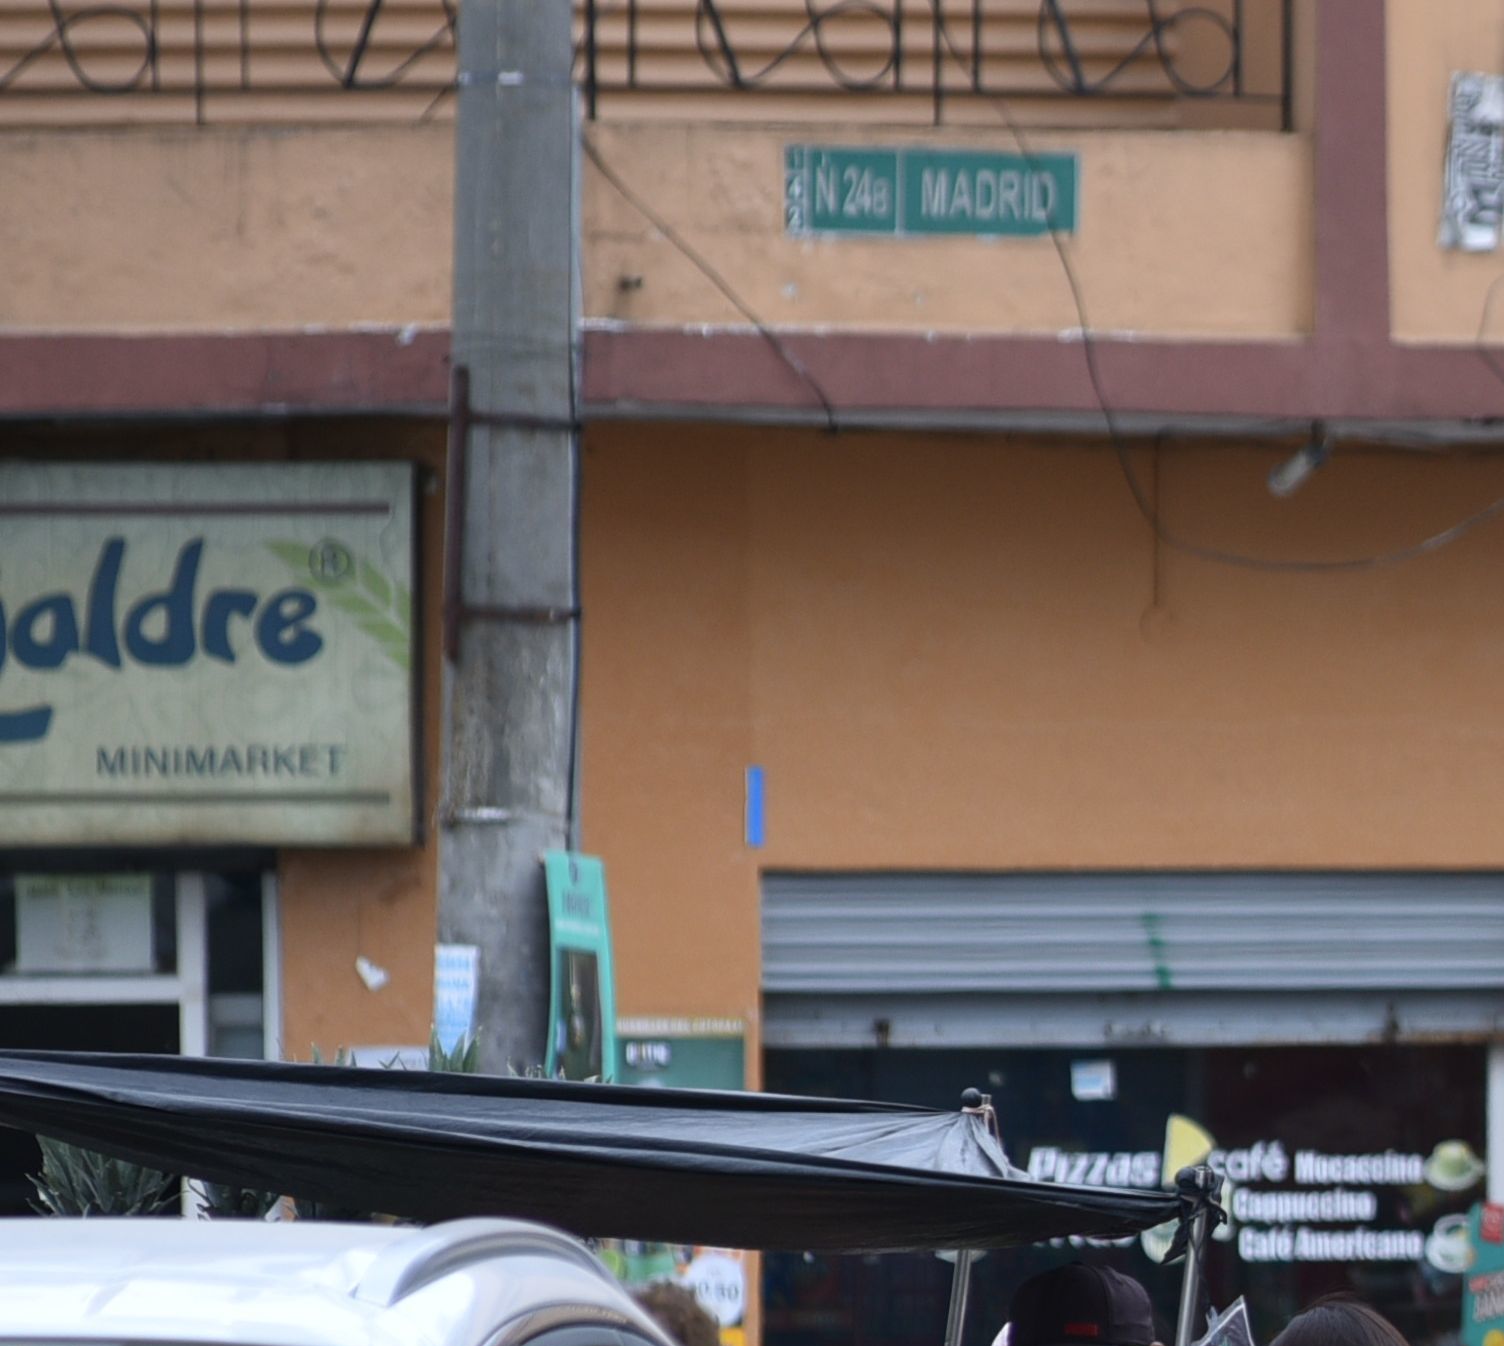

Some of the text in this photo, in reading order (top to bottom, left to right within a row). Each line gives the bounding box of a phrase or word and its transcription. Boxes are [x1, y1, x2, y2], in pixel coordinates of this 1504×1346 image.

[815, 166, 835, 216] N
[920, 166, 1056, 221] MADRID
[0, 534, 323, 676] aldre
[96, 744, 345, 777] MINIMARKET
[1028, 1146, 1161, 1187] Pizzas
[1238, 1225, 1295, 1261] Café
